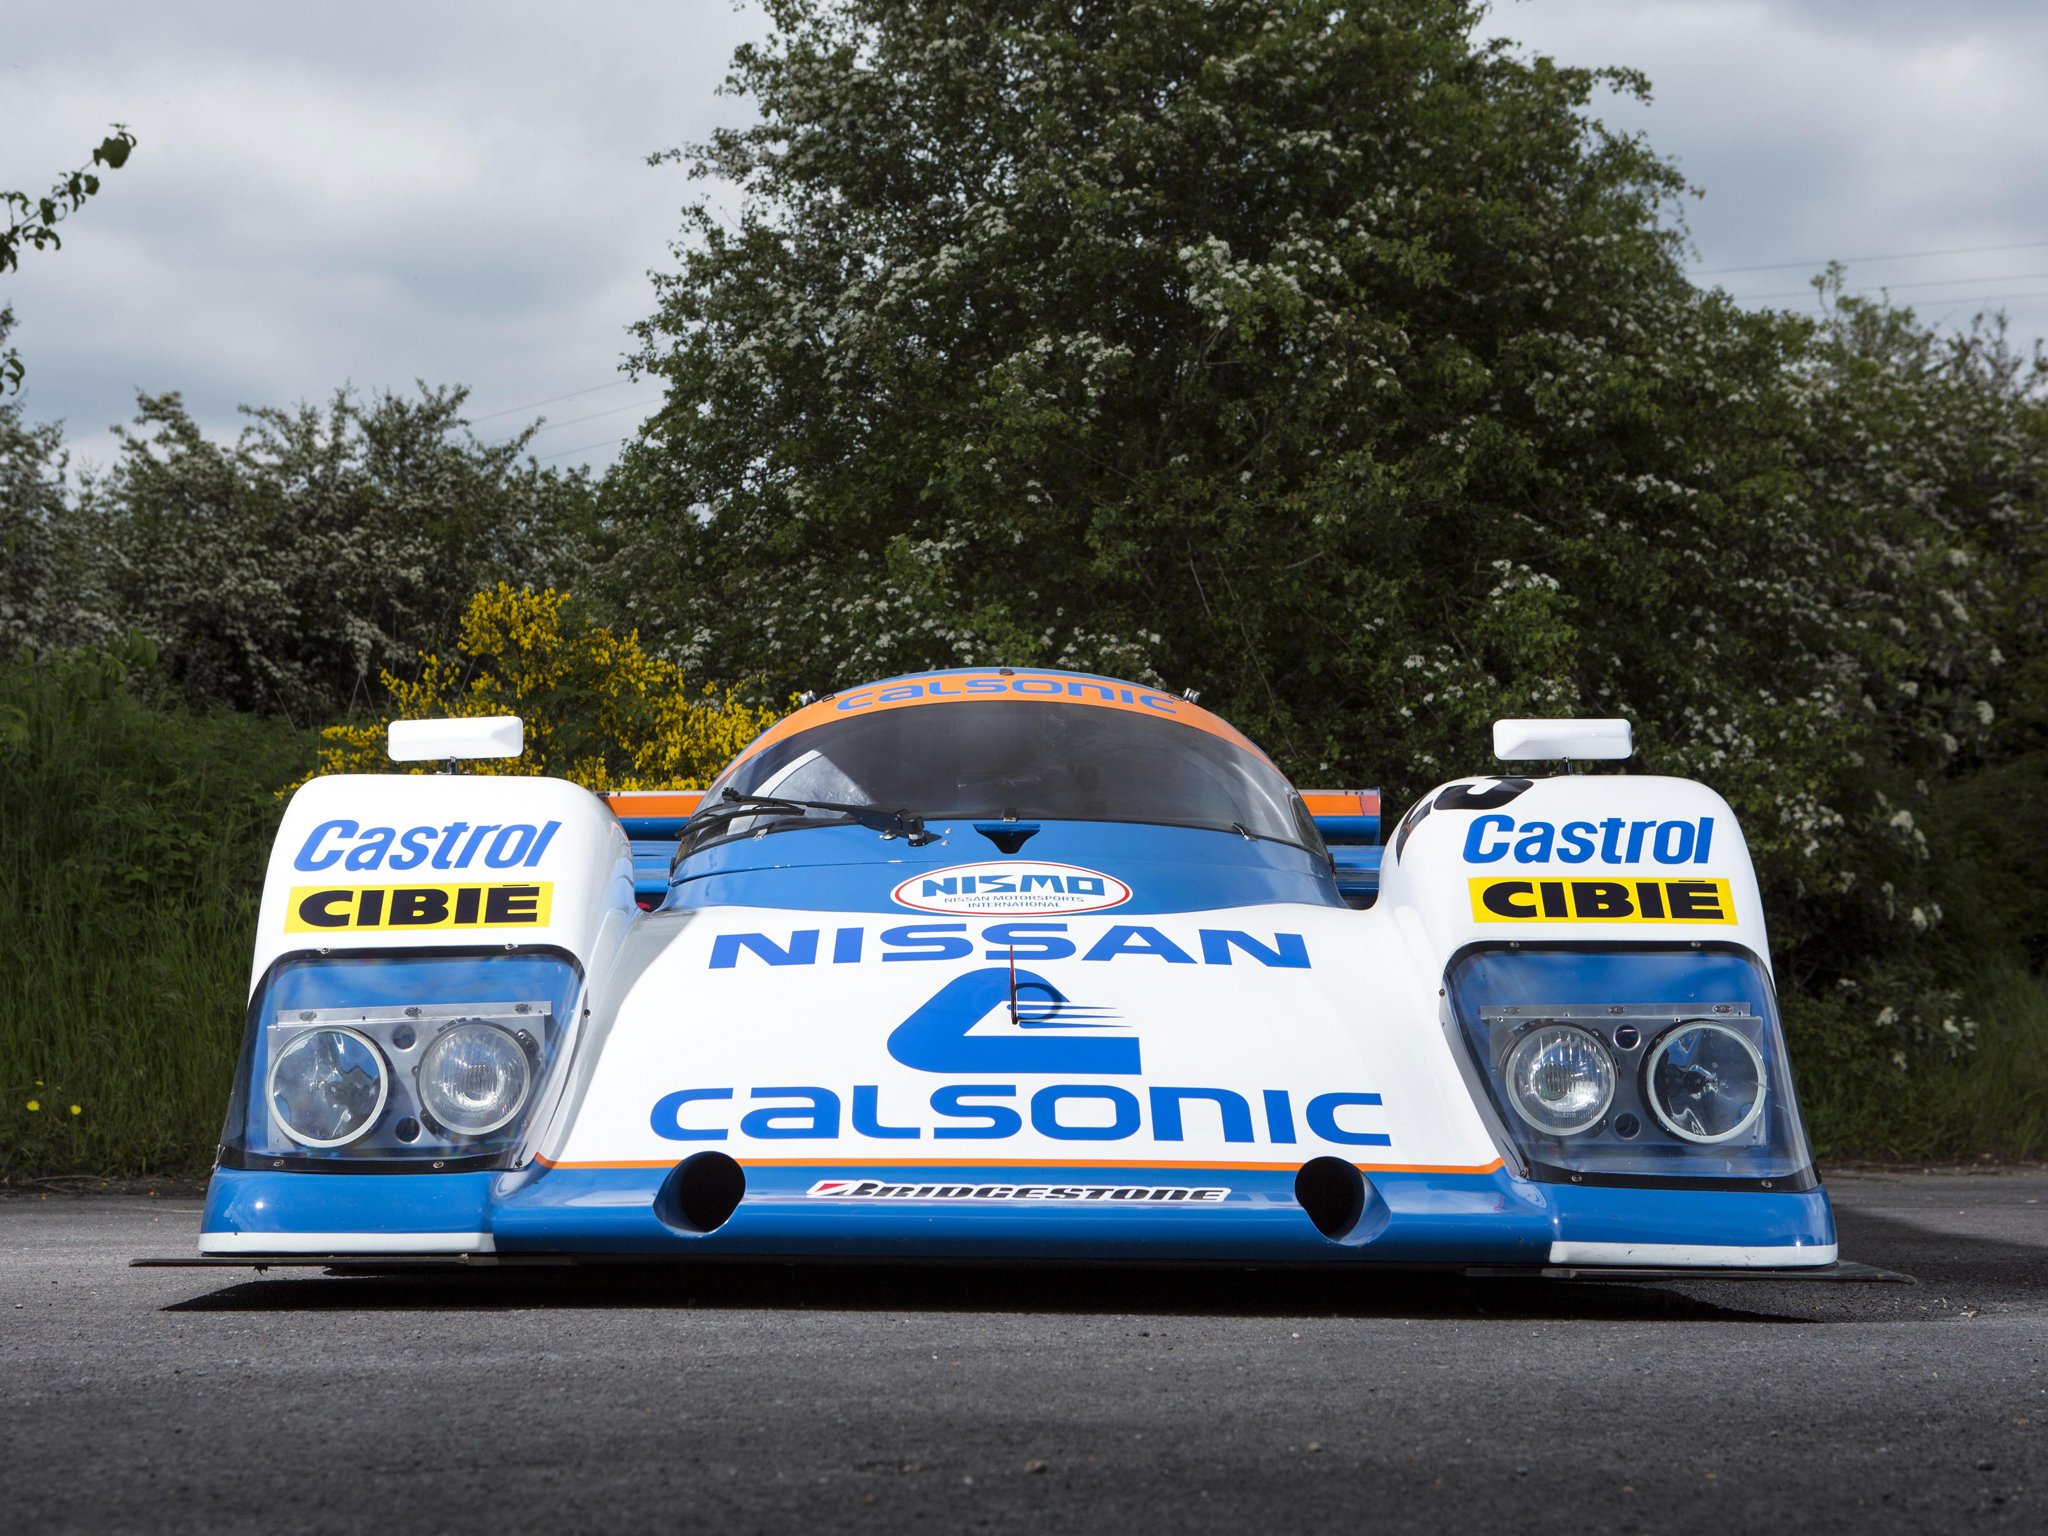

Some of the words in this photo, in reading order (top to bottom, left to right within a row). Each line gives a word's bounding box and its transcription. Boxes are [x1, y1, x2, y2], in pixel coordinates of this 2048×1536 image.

[293, 819, 563, 872] Castrol
[1462, 813, 1715, 865] Castrol
[922, 874, 1106, 898] NISMO
[944, 895, 991, 903] NISSAN
[993, 894, 1085, 903] MOTORSPORTS
[968, 901, 1062, 909] INTERNATIONAL
[708, 922, 1312, 970] NISSAN
[842, 1181, 1226, 1202] BRIDGESTONE
